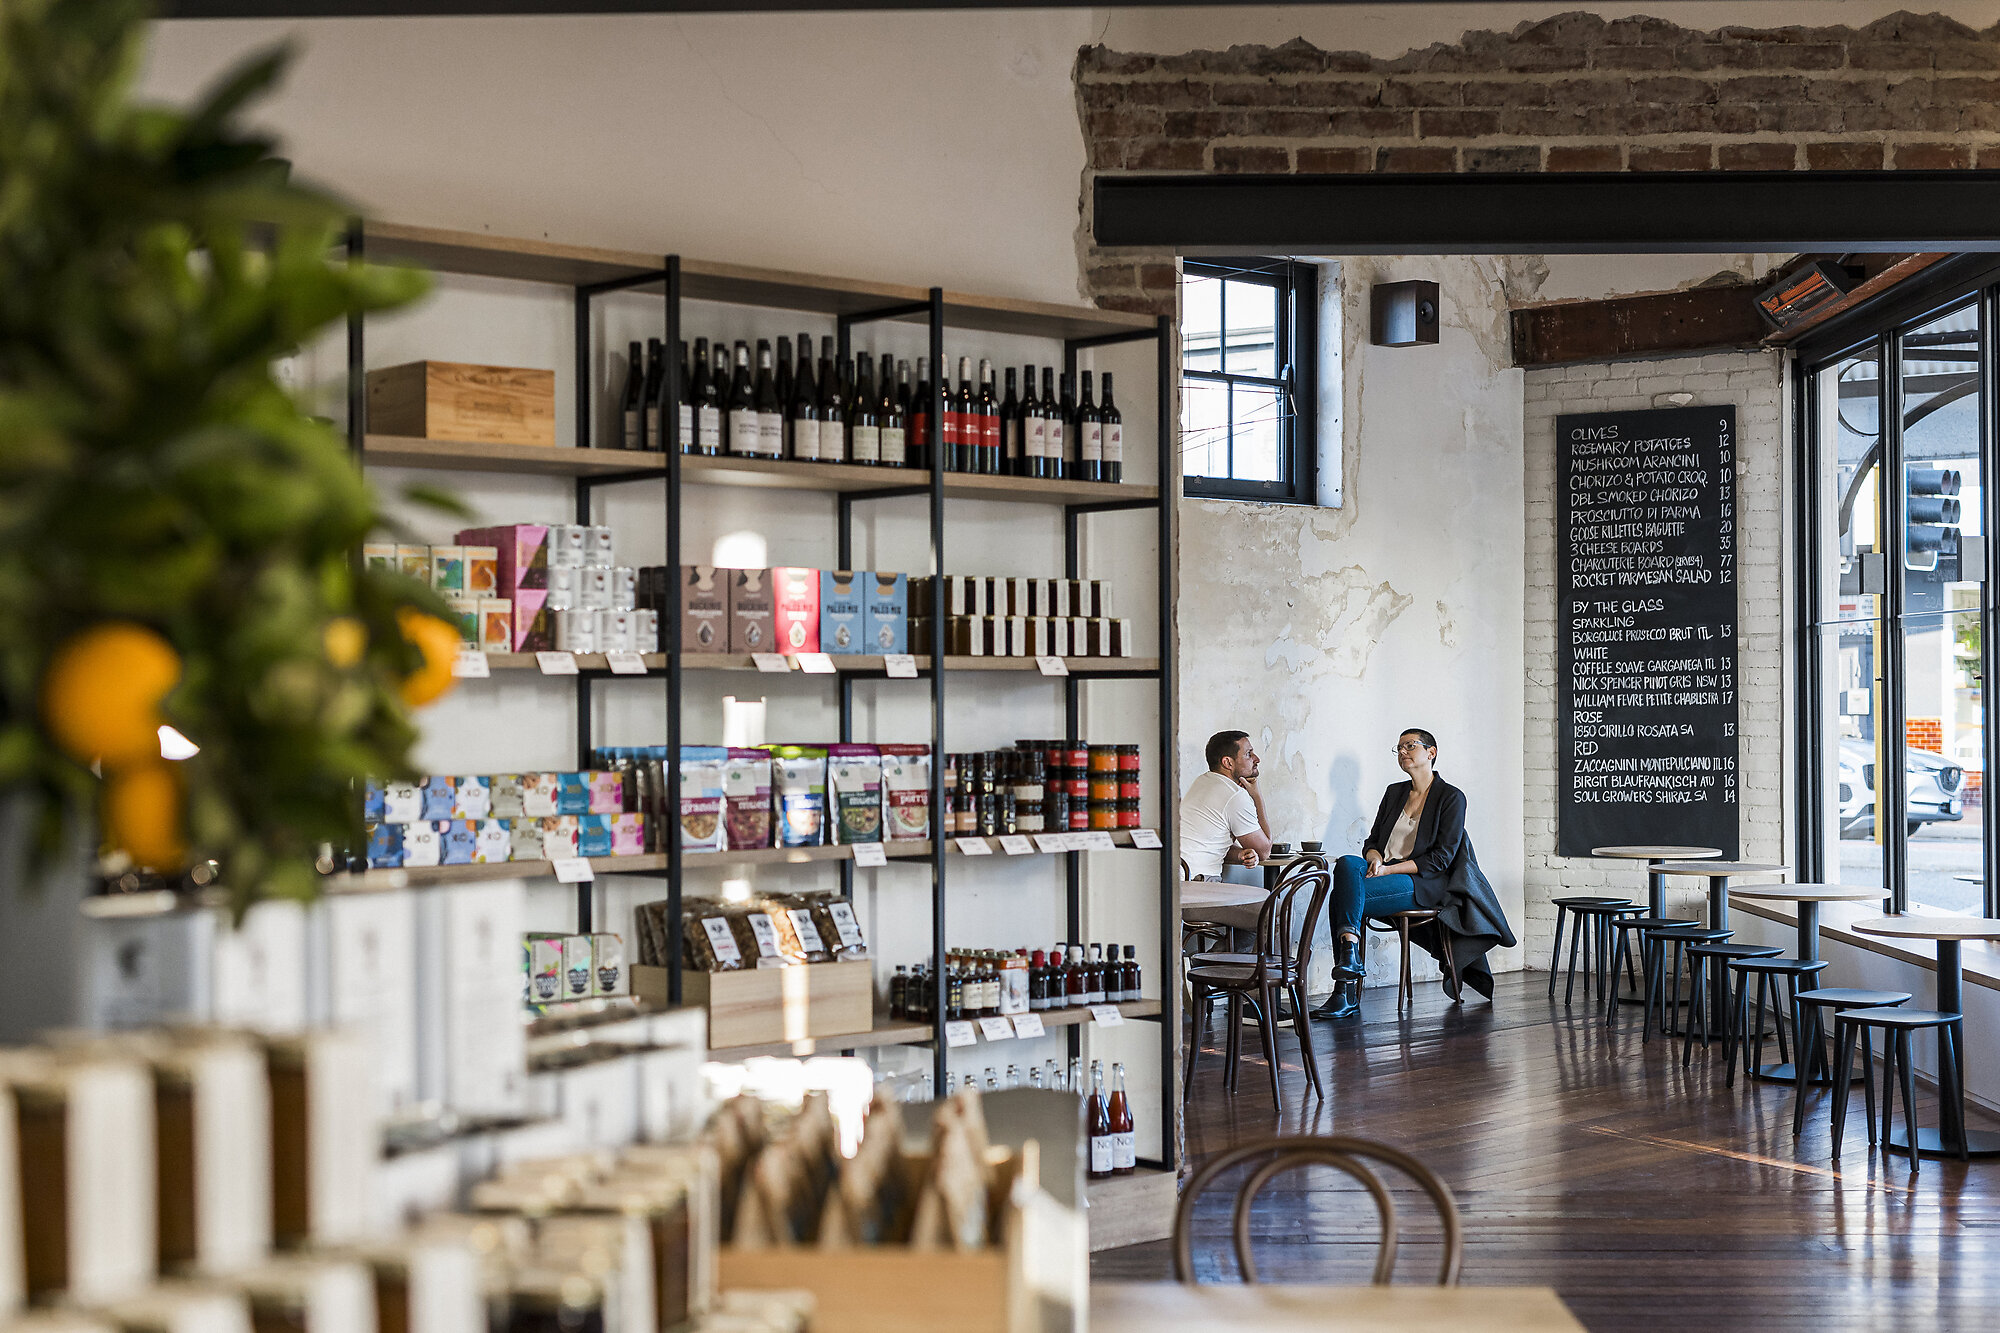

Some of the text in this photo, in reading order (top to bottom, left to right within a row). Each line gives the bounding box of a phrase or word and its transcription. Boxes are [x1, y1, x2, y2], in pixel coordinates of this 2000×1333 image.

[1571, 419, 1727, 440] OLIVES 9
[1572, 440, 1630, 455] ROSEMARY
[1718, 434, 1729, 448] 12
[1571, 450, 1730, 472] MUSHROOM ARANCINI 10
[1570, 475, 1622, 490] CHORIZO
[1625, 473, 1634, 487] &
[1637, 471, 1675, 486] POTATO
[1720, 468, 1731, 483] 10
[1571, 486, 1730, 507] DBL SMOKED CHORIZO 13
[1571, 503, 1731, 524] PROSCIUTTO DI PARMA 16
[1570, 526, 1599, 541] GOOSE
[1646, 522, 1685, 536] BAGUETTE
[1720, 521, 1732, 533] 20
[1580, 542, 1618, 555] CHEESE
[1621, 541, 1663, 554] BOARDS
[1720, 536, 1731, 549] 35
[1638, 556, 1674, 570] BOARD
[1721, 555, 1732, 567] 77
[1573, 569, 1731, 588] ROCKET PARMESAN SALAD 12
[1572, 599, 1664, 613] BY THE GLASS
[1573, 616, 1634, 629] SPARKLING
[1573, 630, 1623, 644] BORGOLUCE
[1669, 627, 1693, 641] BRUT
[1720, 625, 1731, 638] 13
[1573, 647, 1608, 659] WHITE
[1573, 662, 1612, 675] COFFELE
[1615, 660, 1644, 674] SOAVE
[1648, 658, 1703, 673] GARGANEGA
[1721, 657, 1731, 670] 13
[1573, 675, 1731, 690] NICK SPENCER PINOT GRIS NSW 13
[1574, 694, 1614, 708] WILLIAM
[1617, 693, 1644, 707] FEVRE
[1646, 692, 1672, 705] PETITE
[1674, 692, 1707, 705] CHABLIS
[1722, 691, 1733, 704] 17
[1574, 711, 1602, 723] ROSE
[1574, 723, 1734, 738] 1850 CIRILLO ROSATA SA 13
[1574, 741, 1598, 756] RED
[1574, 759, 1638, 773] ZACCAGNINI
[1723, 757, 1734, 770] 16
[1574, 776, 1609, 788] BIRGIT
[1612, 775, 1696, 789] BLAUFRANKISCH
[1724, 774, 1735, 787] 16
[1574, 789, 1735, 803] SOUL GROWERS SHIRAZ SA 14
